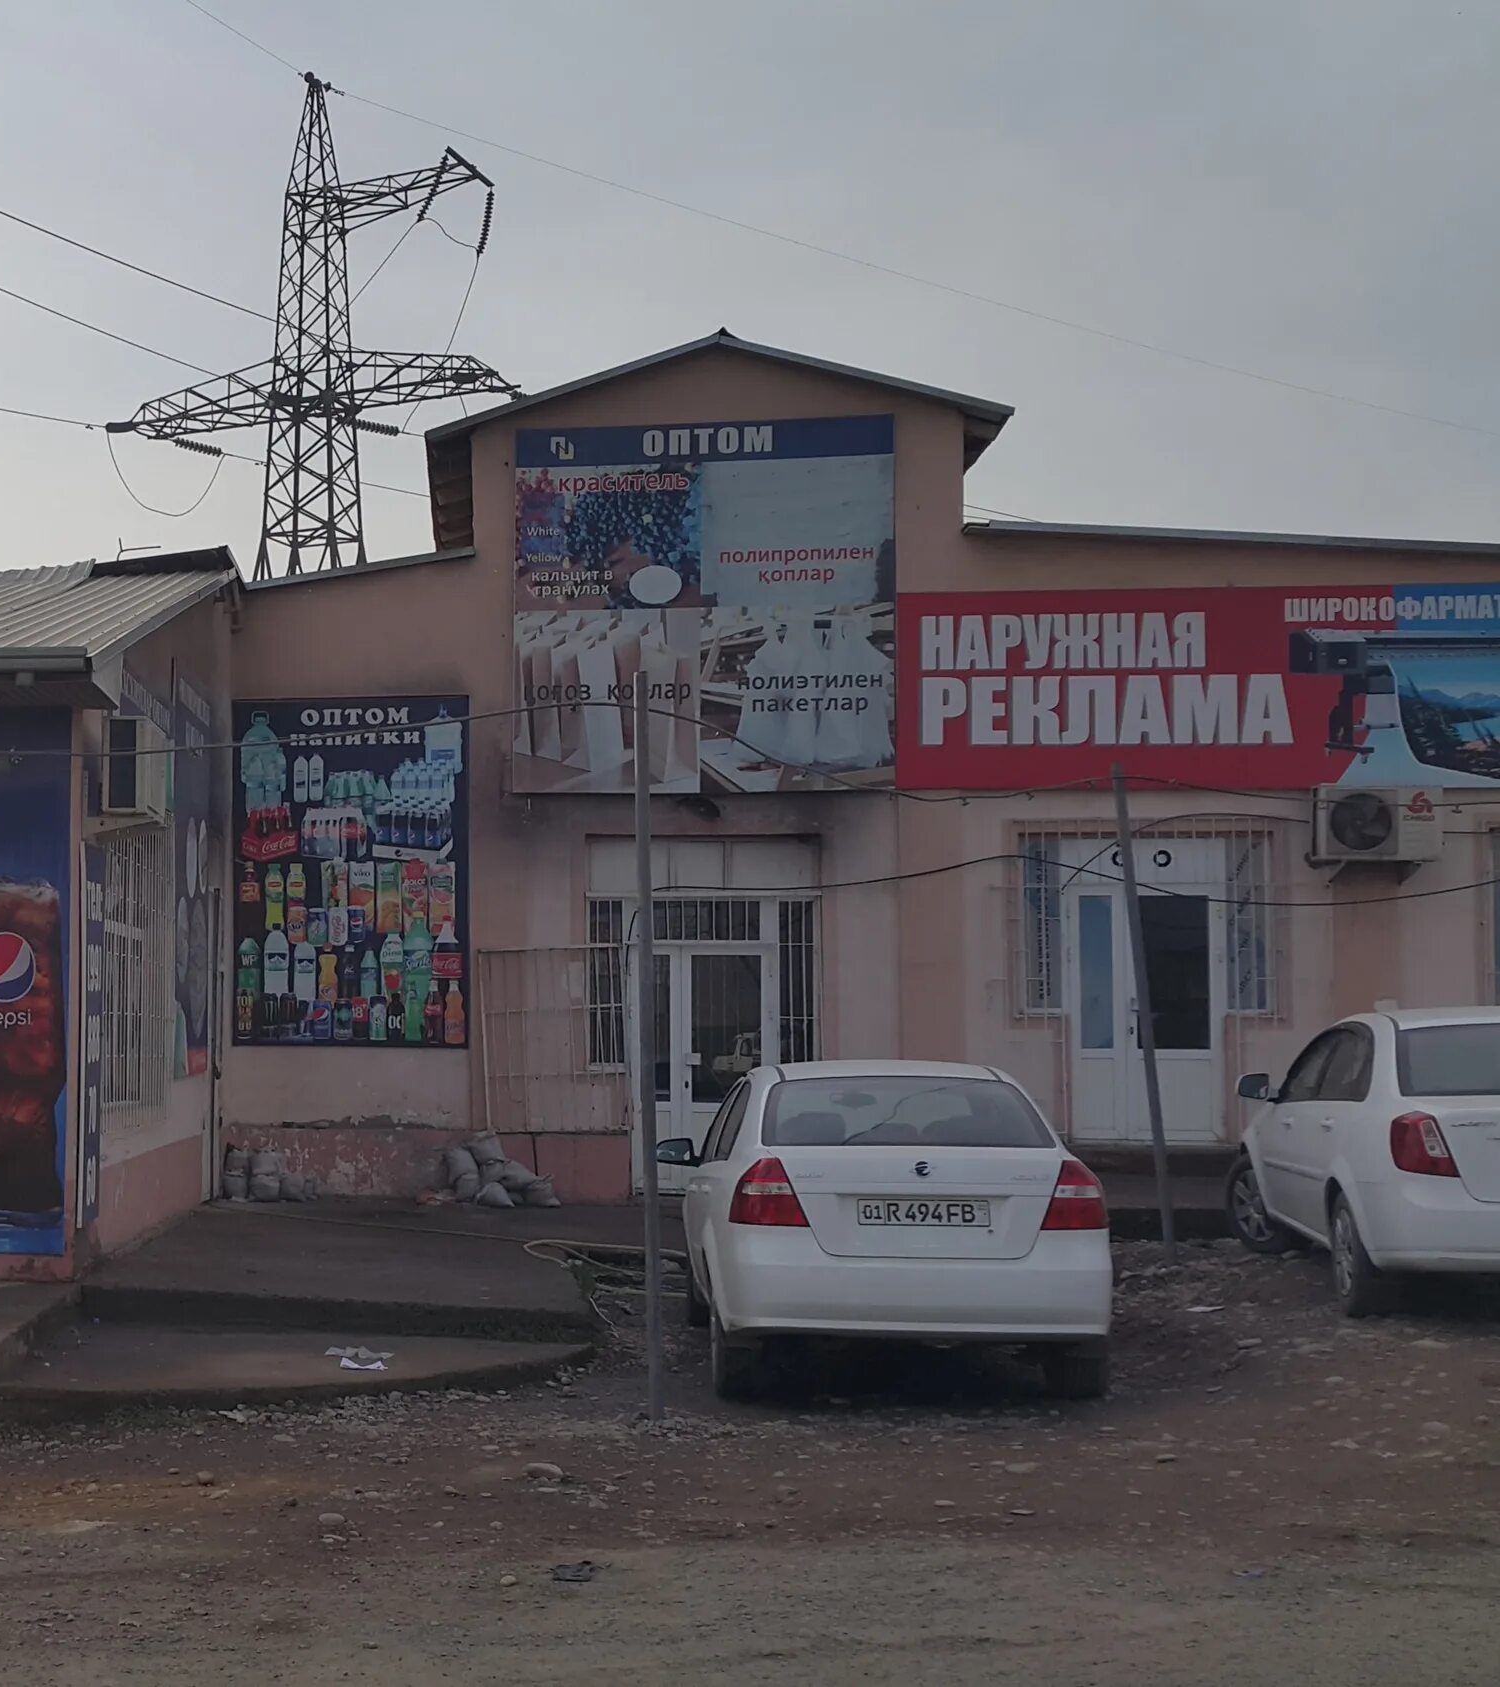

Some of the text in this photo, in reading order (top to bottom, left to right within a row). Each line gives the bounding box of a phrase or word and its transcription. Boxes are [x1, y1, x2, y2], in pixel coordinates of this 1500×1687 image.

[643, 425, 773, 457] ОПТОМ
[557, 472, 691, 497] краситель
[526, 526, 560, 537] White
[525, 552, 562, 563] Yellow
[719, 547, 874, 565] полипропилен
[531, 570, 614, 584] кальцит в
[920, 611, 1207, 671] НАРУЖНАЯ
[737, 673, 883, 690] полиэтилен
[752, 697, 869, 716] пакетлар
[919, 673, 1294, 746] РЕКЛАМА
[300, 706, 410, 727] ОПТОМ
[863, 1204, 883, 1220] 01
